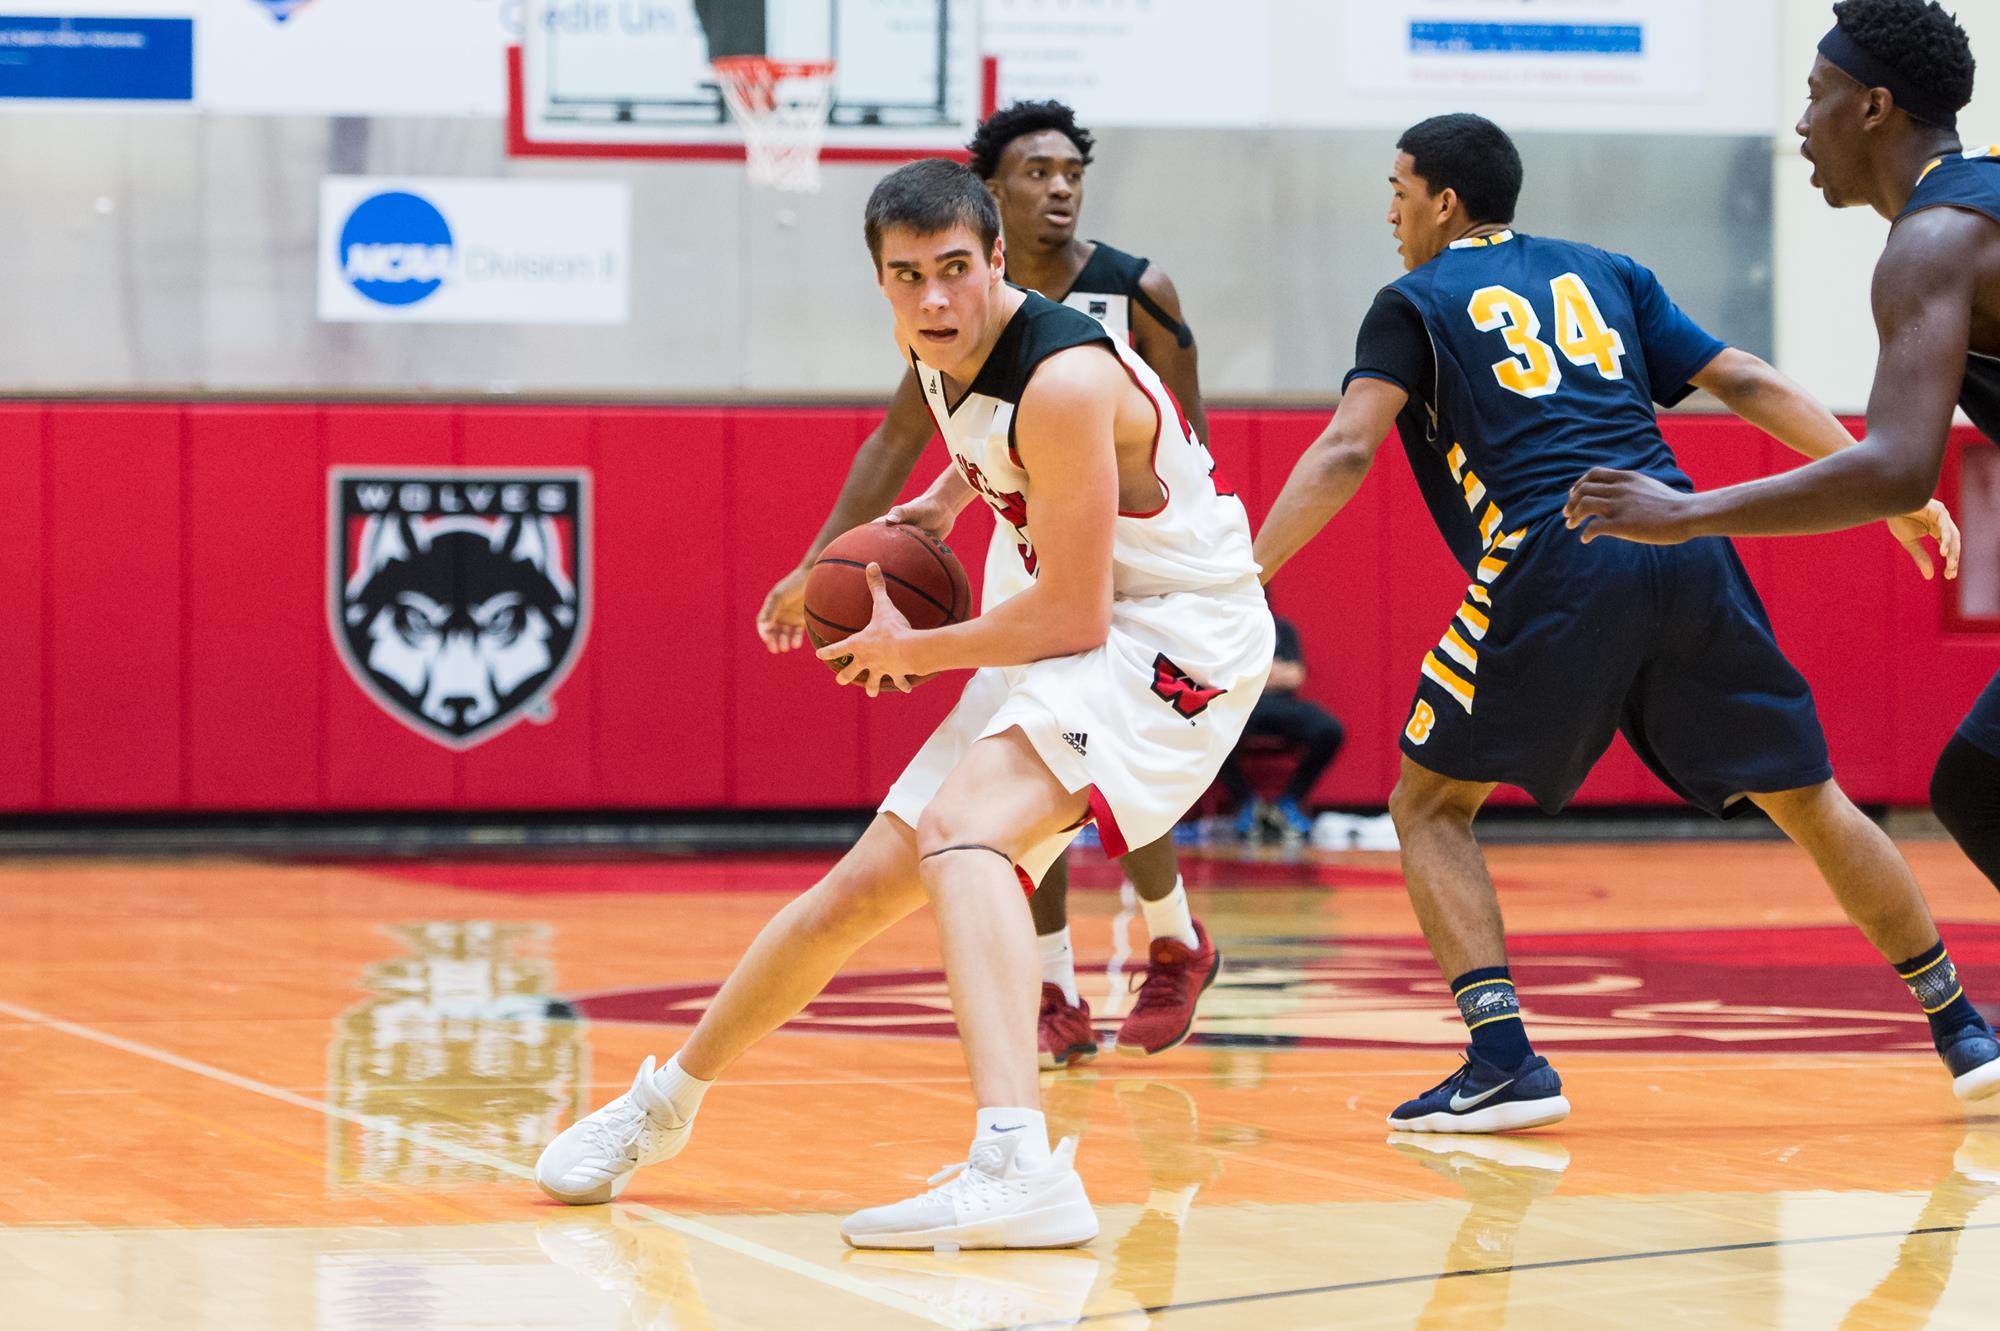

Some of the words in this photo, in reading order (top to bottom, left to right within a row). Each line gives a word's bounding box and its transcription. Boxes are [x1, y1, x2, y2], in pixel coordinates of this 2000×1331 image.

[1467, 272, 1626, 398] 34
[355, 483, 567, 513] WOLVES
[1405, 698, 1436, 746] B
[1062, 732, 1087, 757] adidas
